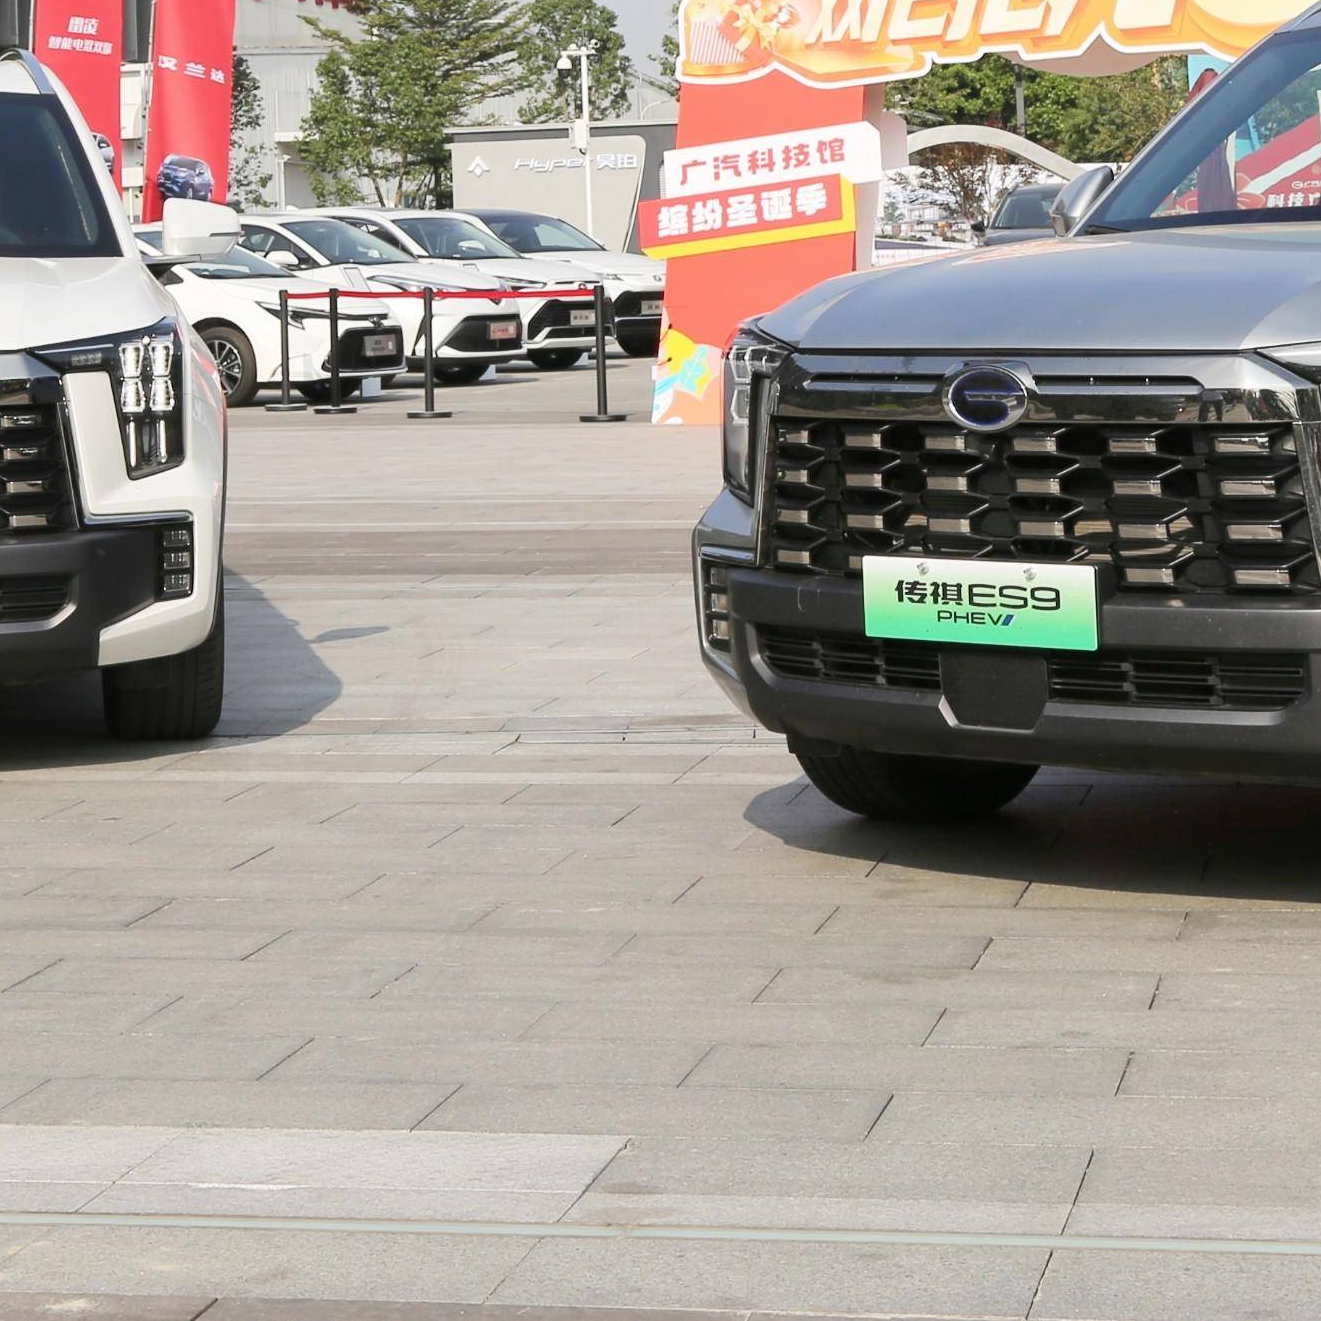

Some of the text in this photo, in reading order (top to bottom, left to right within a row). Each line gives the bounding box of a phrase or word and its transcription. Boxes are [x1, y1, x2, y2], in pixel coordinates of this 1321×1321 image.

[68, 16, 100, 35] 雷凌
[157, 54, 225, 85] 汉兰达
[680, 137, 846, 186] 广汽科技馆
[657, 181, 827, 238] 缤纷圣诞季
[894, 579, 1061, 611] 传祺ES9
[937, 610, 1004, 626] PHEV
